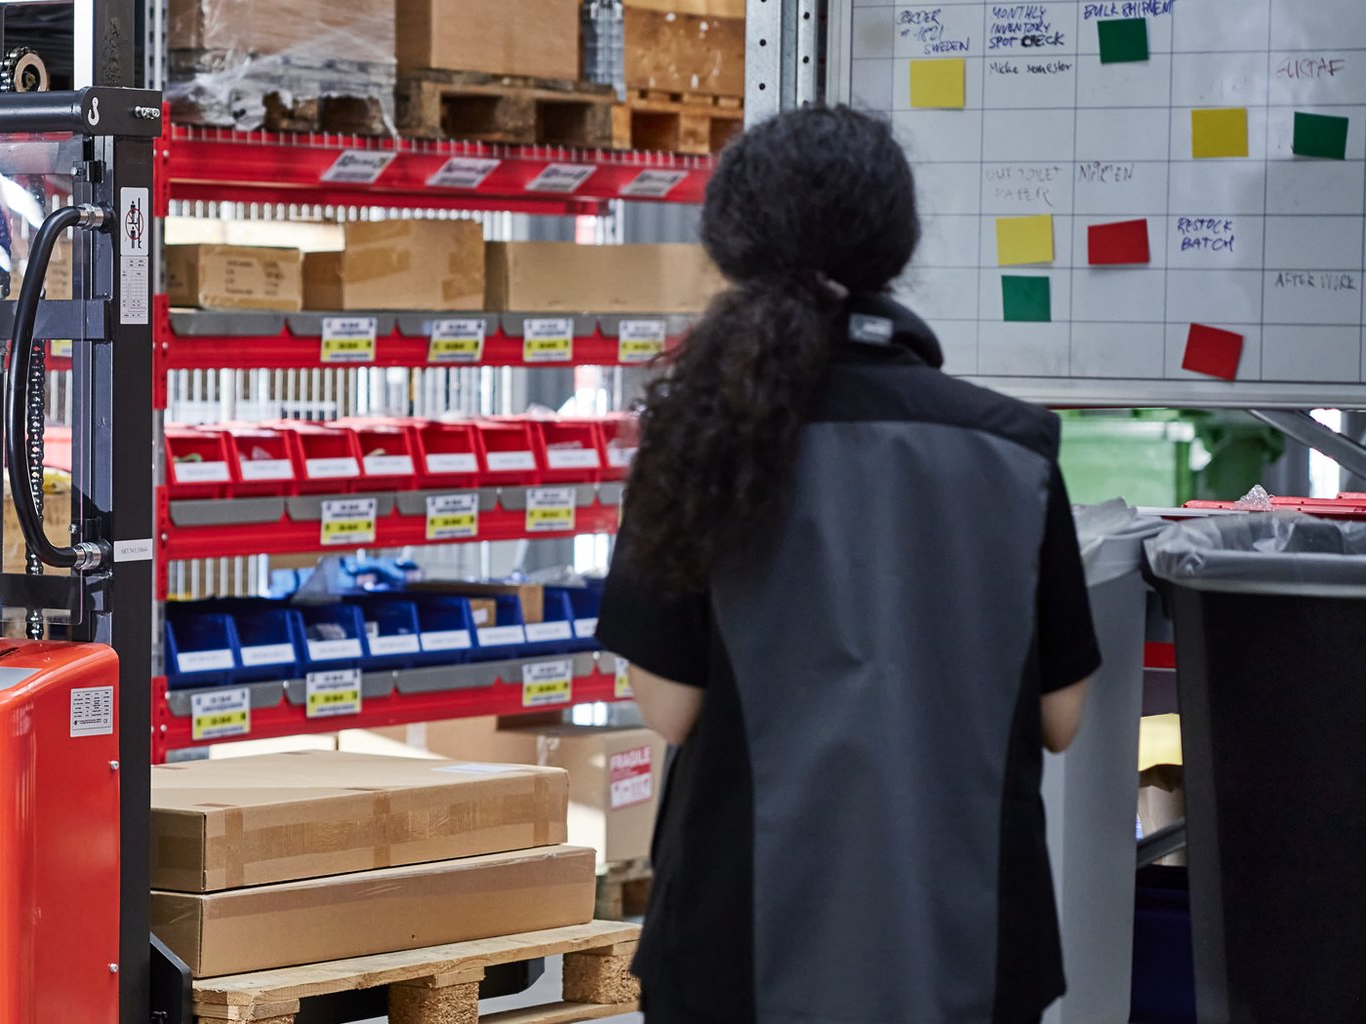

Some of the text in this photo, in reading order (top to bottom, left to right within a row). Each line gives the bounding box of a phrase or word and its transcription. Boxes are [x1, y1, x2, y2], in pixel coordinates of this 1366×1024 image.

[992, 5, 1046, 23] MONTHLY
[1084, 3, 1119, 19] BULK
[990, 22, 1050, 35] INVENTORY
[923, 37, 970, 54] SWEDEN
[989, 36, 1017, 49] SPOT
[1177, 217, 1233, 234] RESTOCK
[1180, 235, 1235, 253] BATCH
